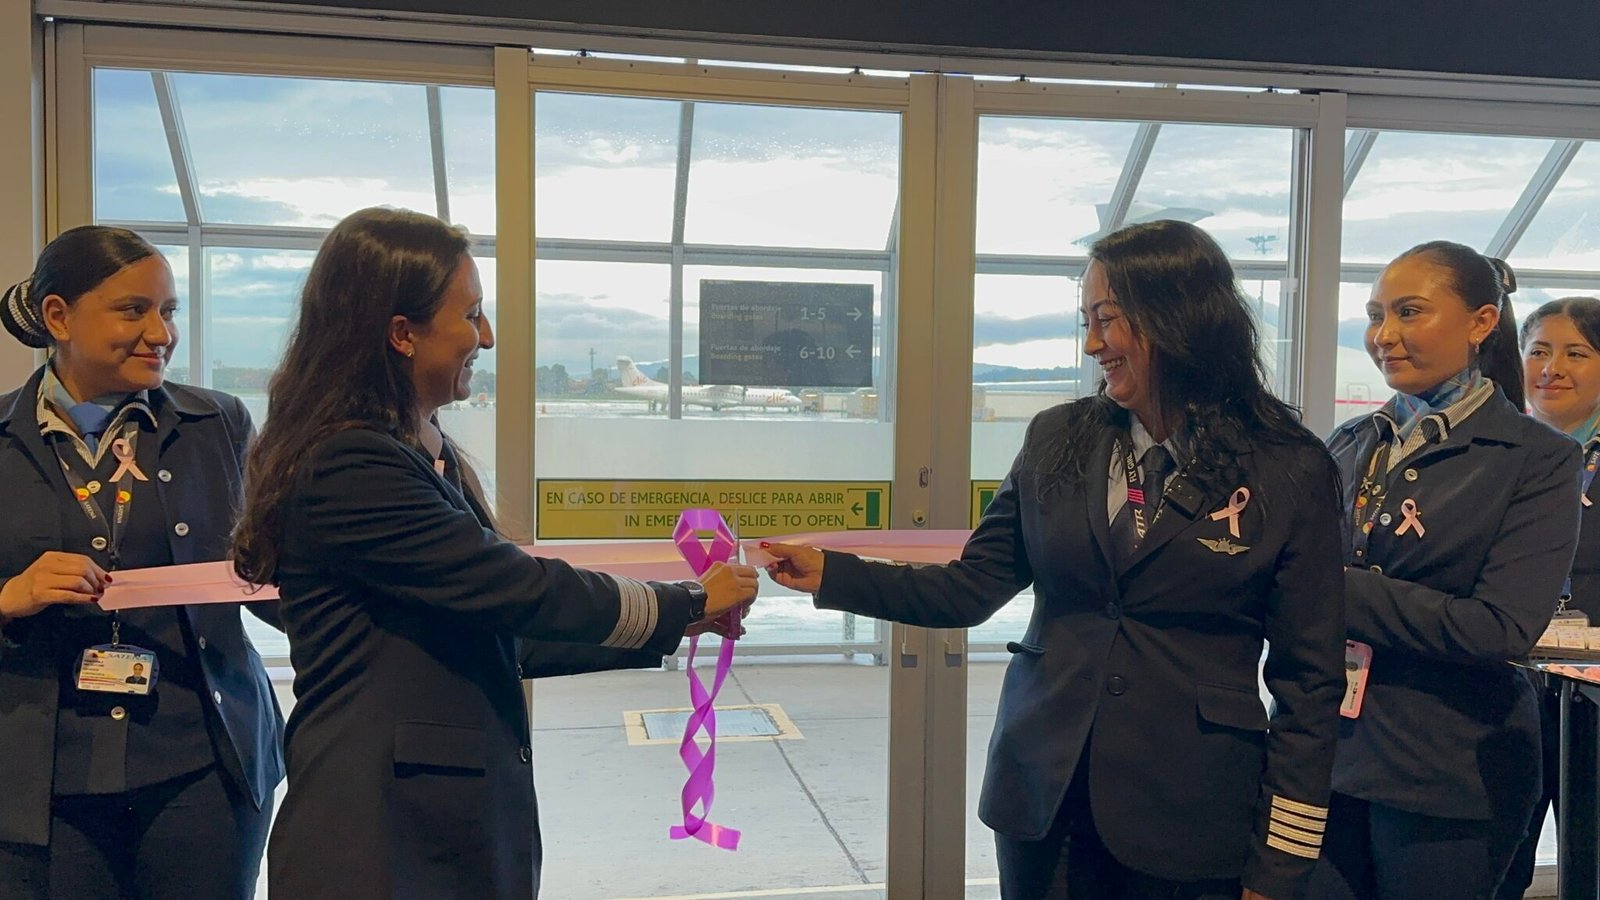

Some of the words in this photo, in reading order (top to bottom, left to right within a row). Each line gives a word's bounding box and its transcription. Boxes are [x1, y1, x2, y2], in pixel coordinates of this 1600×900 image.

[711, 303, 738, 311] Puertas
[739, 303, 748, 311] de
[751, 304, 782, 313] abordaje
[800, 307, 826, 320] 1-5
[710, 353, 742, 361] Boarding
[750, 344, 782, 353] abordaje
[800, 346, 835, 360] 6-10
[767, 391, 785, 404] clic
[1128, 469, 1137, 483] FLY
[546, 492, 563, 504] EN
[568, 492, 605, 504] CASO
[609, 492, 626, 504] DE
[631, 492, 715, 506] EMERGENCIA,
[719, 492, 767, 504] DESLICE
[771, 492, 804, 504] PARA
[808, 492, 844, 504] ABRIR
[625, 515, 640, 527] IN
[740, 515, 777, 527] SLIDE
[782, 515, 801, 527] TO
[807, 515, 845, 527] OPEN
[1134, 508, 1146, 539] ATR
